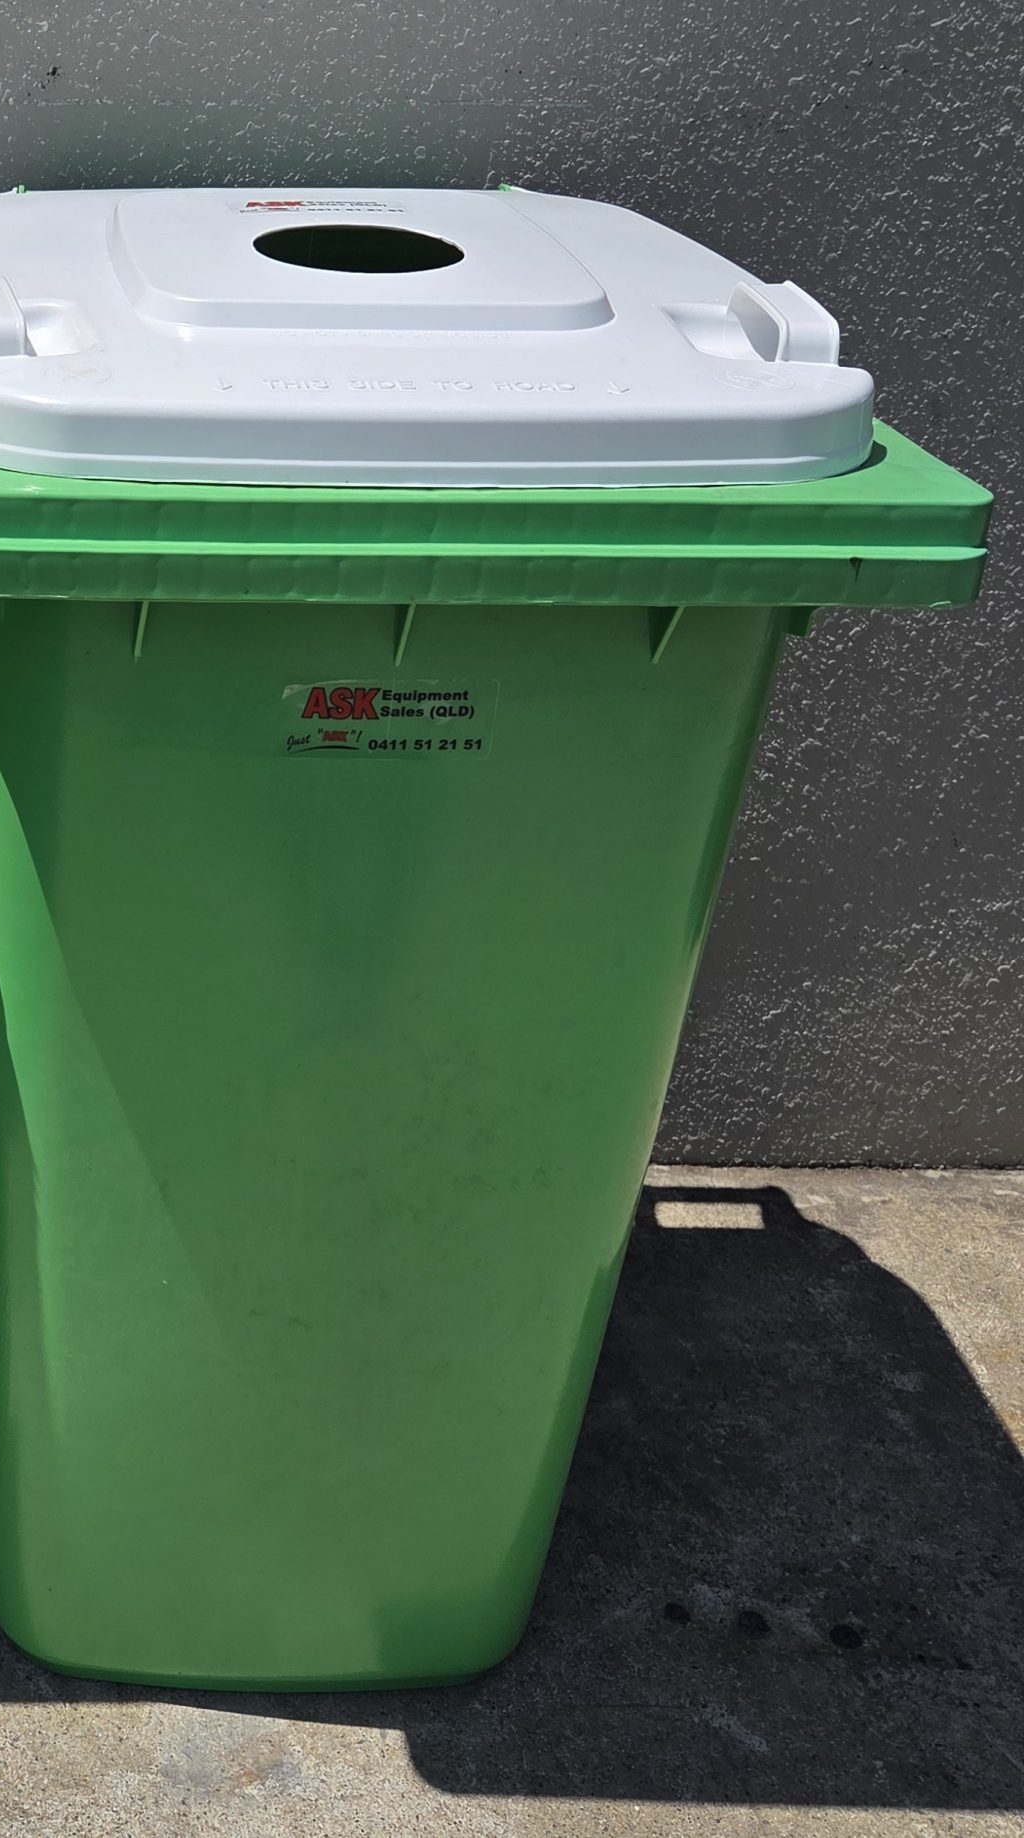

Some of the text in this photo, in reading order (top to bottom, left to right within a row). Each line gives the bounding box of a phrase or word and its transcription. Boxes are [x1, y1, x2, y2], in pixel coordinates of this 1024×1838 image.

[263, 377, 576, 393] THIS SIDE TO ROAD
[381, 689, 469, 702] Equipment
[301, 687, 380, 720] ASK
[379, 705, 475, 719] Sales (QLD)
[287, 734, 311, 751] Just
[367, 738, 483, 751] 0411 51 21 51
